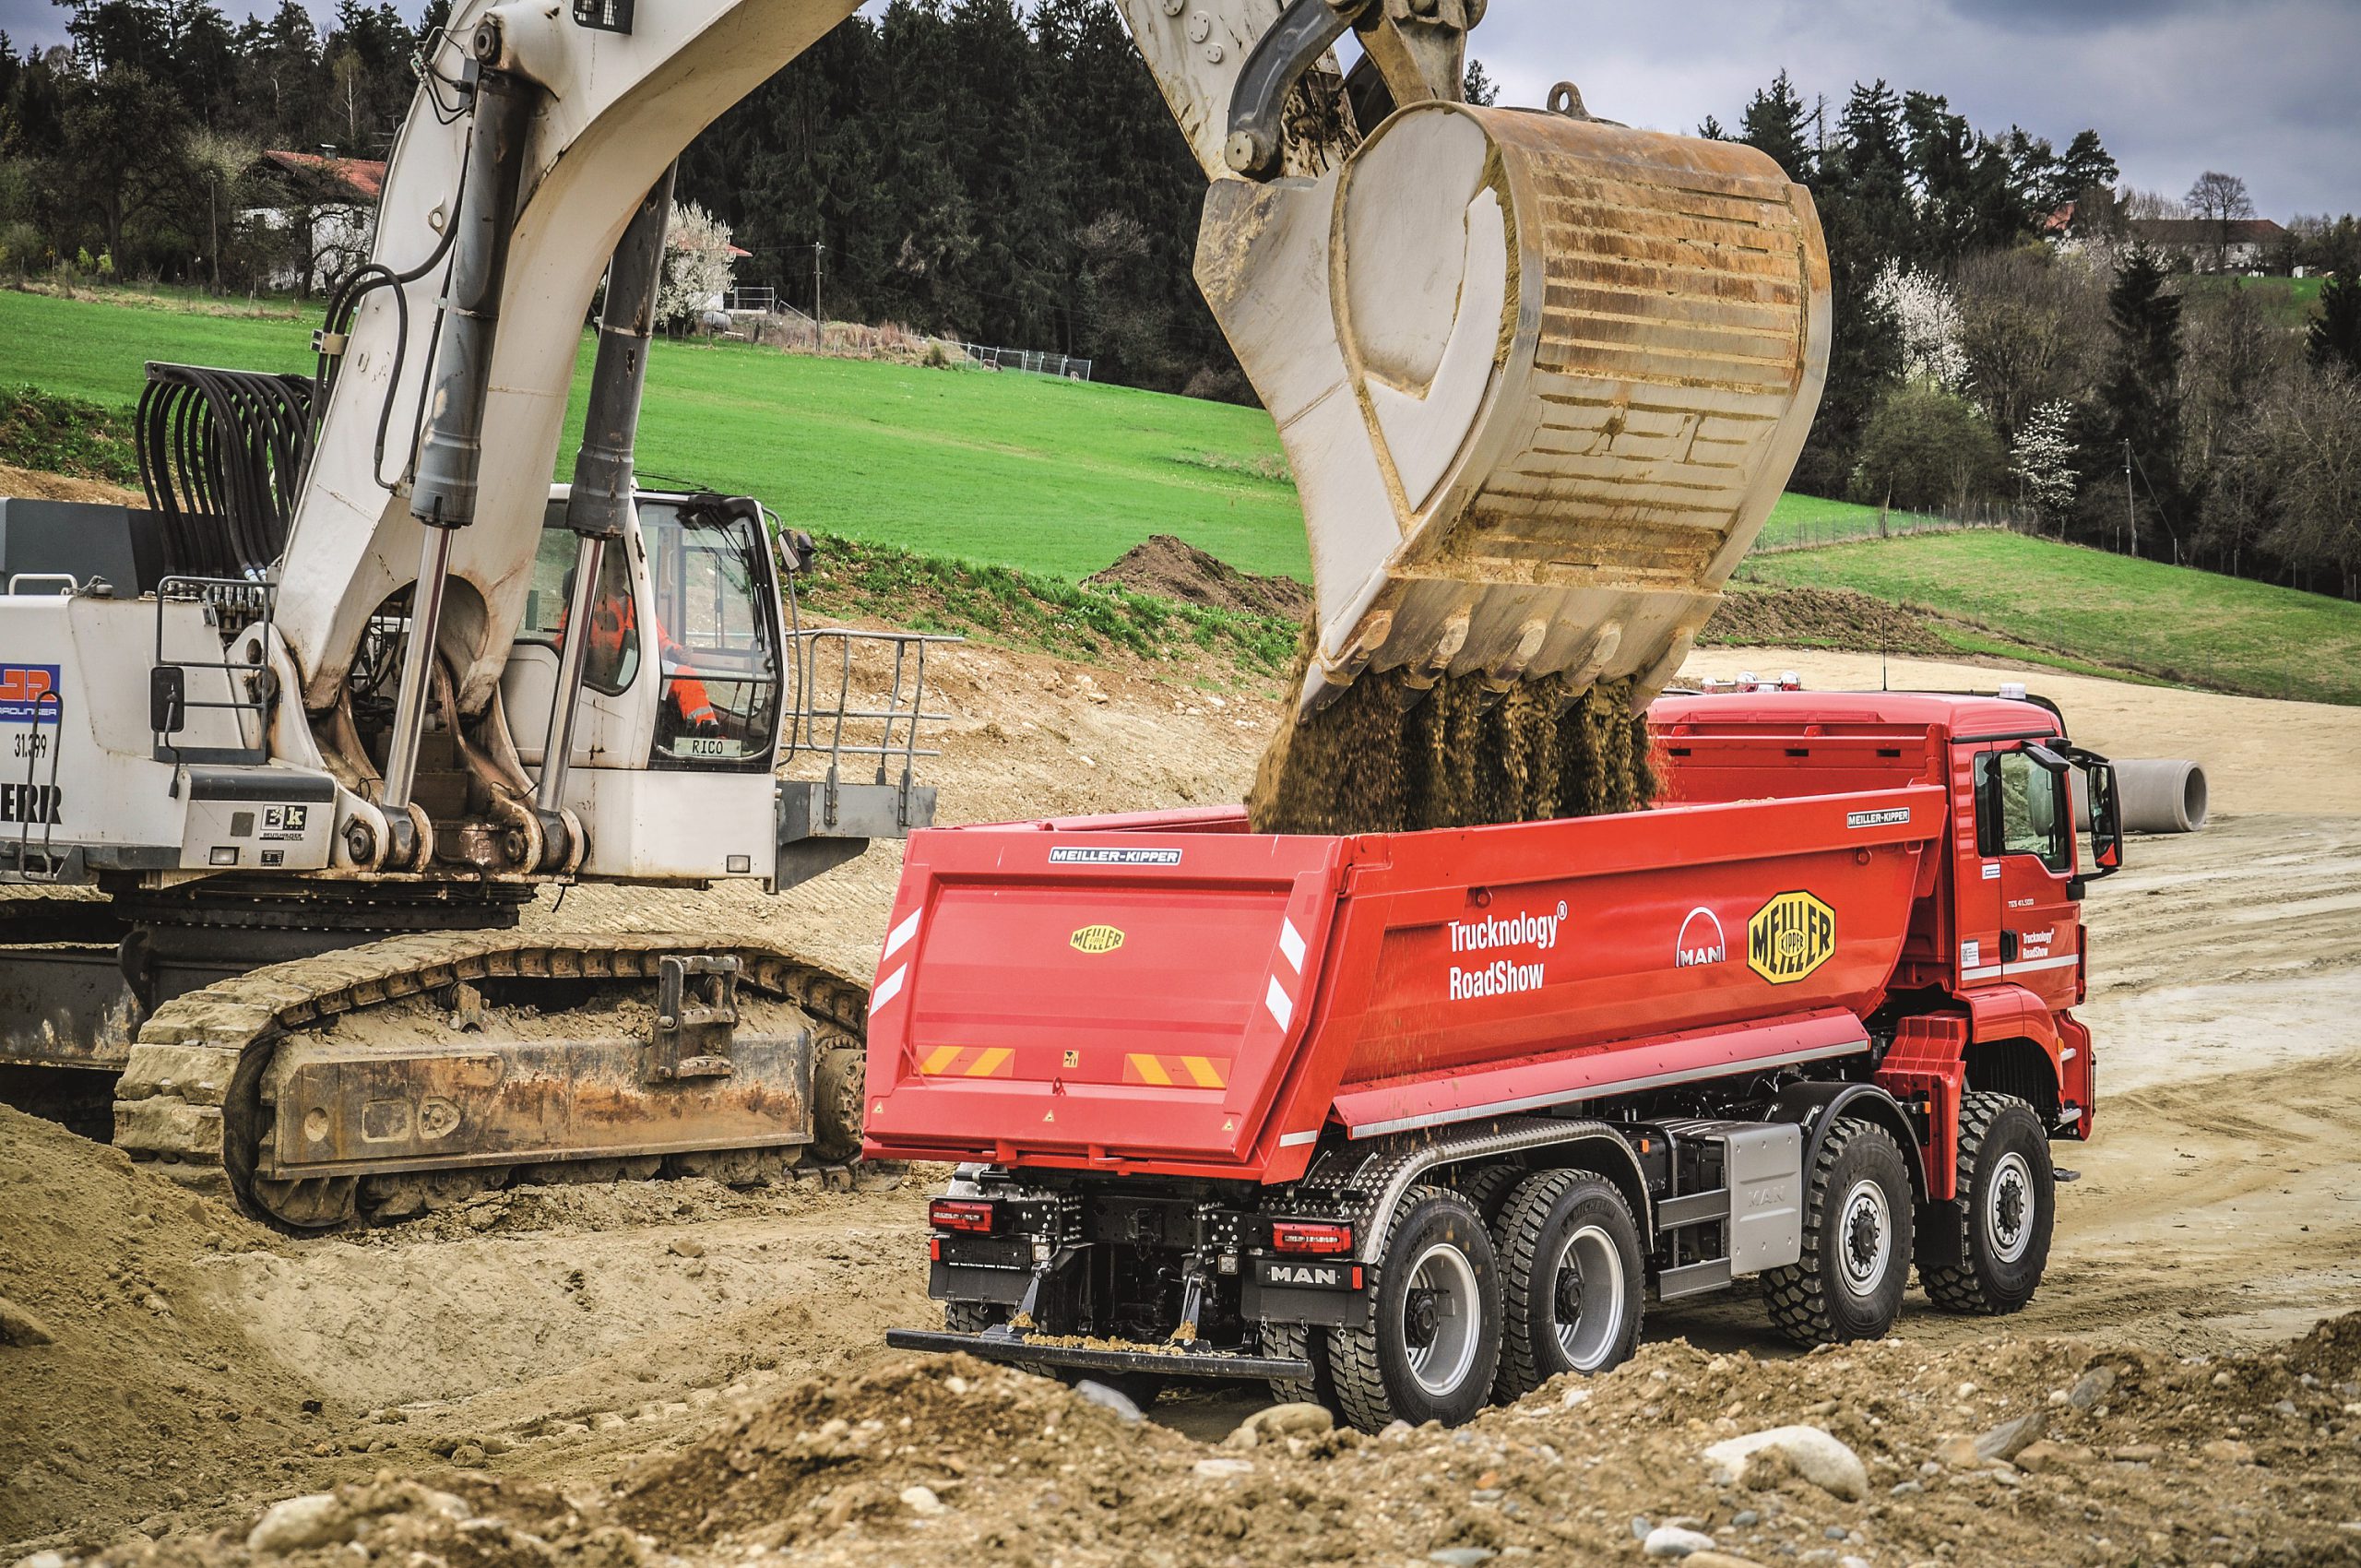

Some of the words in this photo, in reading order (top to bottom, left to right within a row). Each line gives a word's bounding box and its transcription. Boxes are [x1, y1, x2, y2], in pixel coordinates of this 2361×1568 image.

[693, 741, 723, 754] RICO
[0, 783, 62, 825] ERR
[1848, 811, 1908, 826] MEILLER-KIPPER
[1051, 849, 1179, 863] MEILLER-KIPPER
[1073, 928, 1122, 951] MEILLER
[1753, 901, 1831, 975] MEILLER
[1781, 932, 1804, 954] KIPPER
[1679, 945, 1721, 967] MAN
[2023, 946, 2048, 959] RoadShow
[1449, 959, 1545, 1001] RoadShow
[1748, 1186, 1786, 1207] MAN
[1271, 1265, 1336, 1285] MAN
